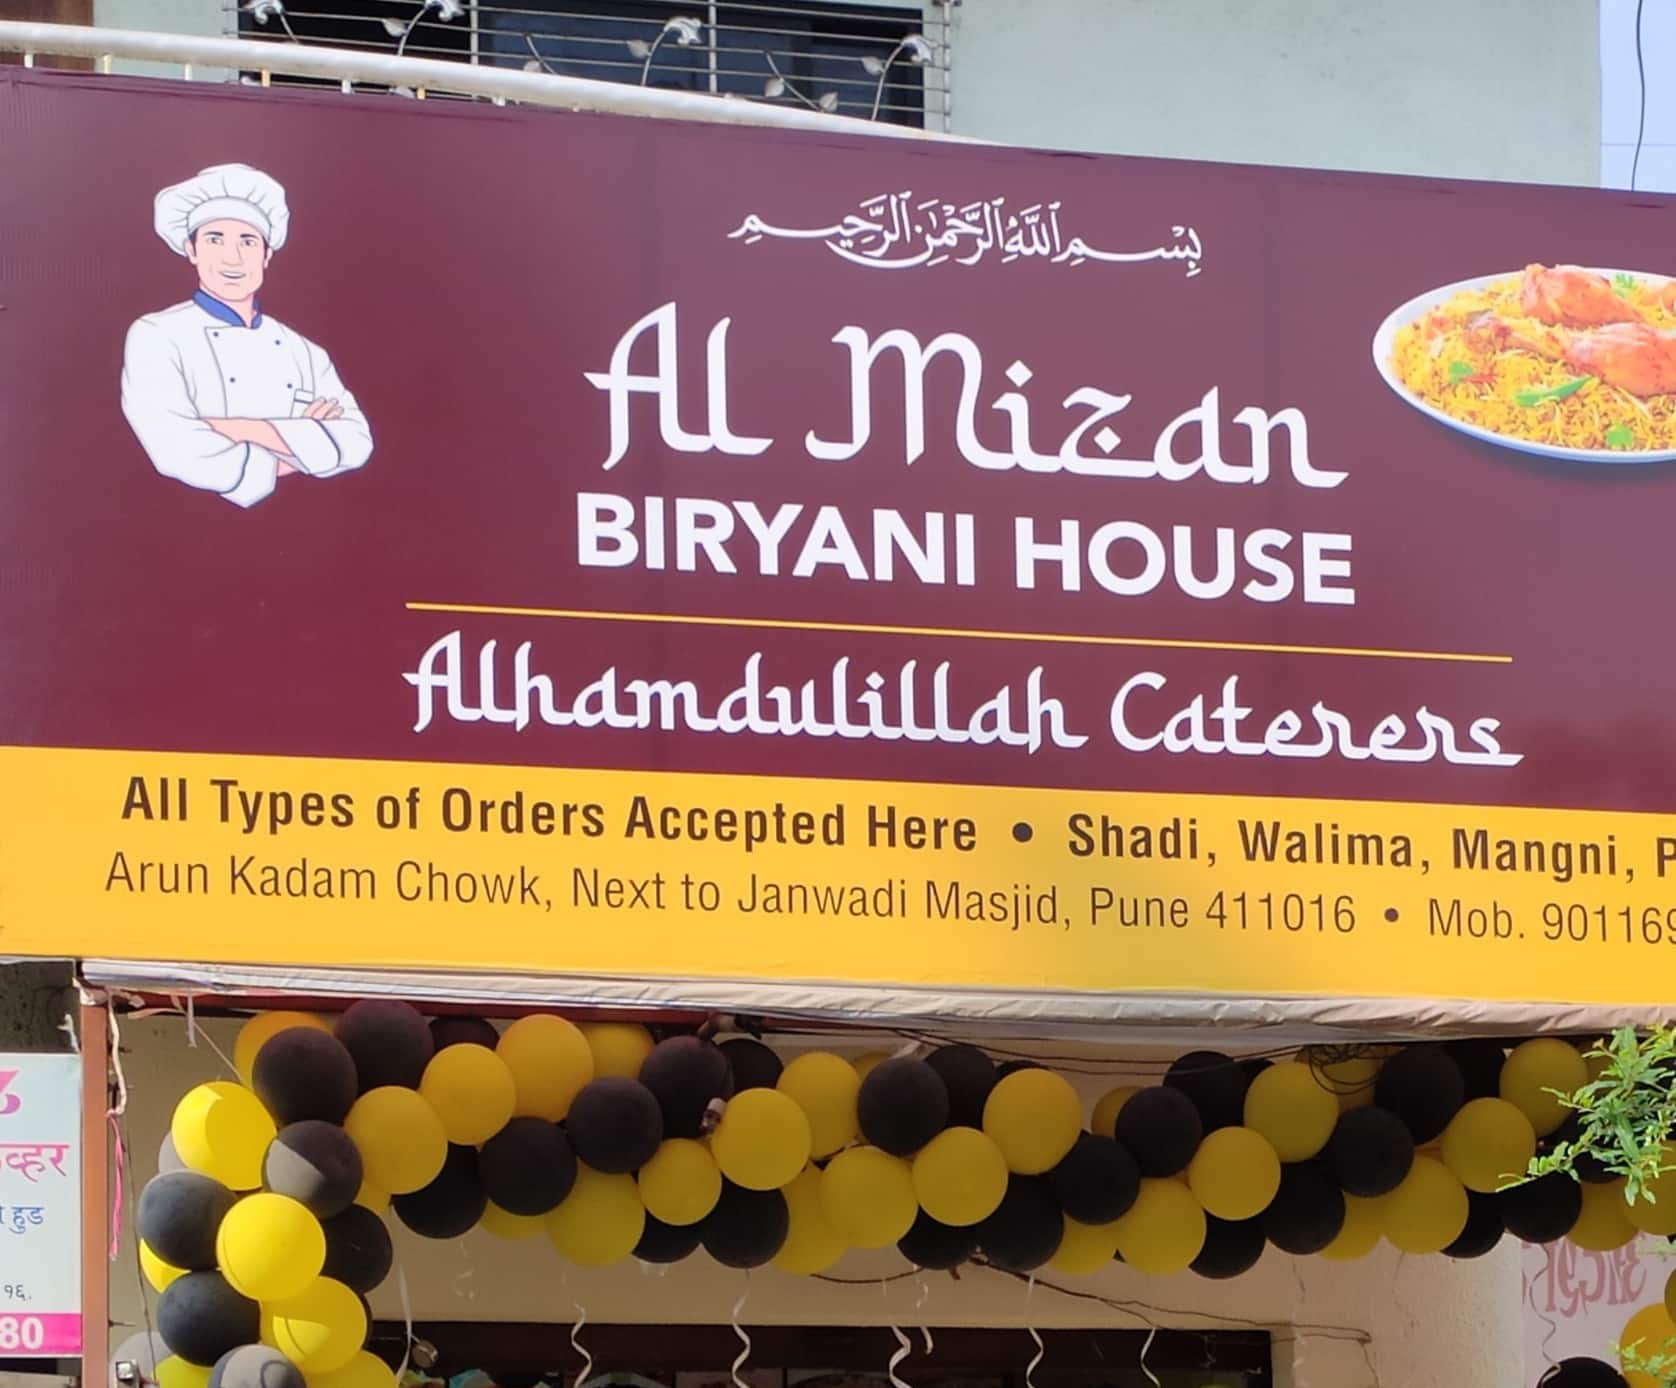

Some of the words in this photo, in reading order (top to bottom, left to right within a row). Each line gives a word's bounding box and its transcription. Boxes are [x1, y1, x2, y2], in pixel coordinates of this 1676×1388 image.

[584, 302, 773, 470] Al
[805, 326, 1349, 488] Mizan
[578, 493, 975, 585] BIRYANI
[1015, 517, 1355, 604] HOUSE
[403, 631, 1088, 754] Alhamdulillah
[1111, 672, 1524, 765] Caterers
[122, 777, 186, 820] All
[210, 780, 353, 834] Types
[377, 787, 419, 829] of
[443, 788, 603, 837] Orders
[625, 797, 844, 852] Accepted
[869, 806, 976, 851] Here
[1069, 814, 1215, 866] Shadi,
[1238, 820, 1428, 874] Walima,
[1454, 829, 1633, 882] Mangni,
[106, 852, 207, 893] Arun
[231, 856, 374, 898] Kadam
[397, 861, 550, 910] Chowk,
[574, 868, 665, 909] Next
[682, 874, 719, 911] to
[738, 874, 905, 917] Janwadi
[927, 881, 1069, 930] Masjid,
[1091, 888, 1188, 927] Pune
[1206, 892, 1355, 932] 411016
[1430, 899, 1523, 938] Mob.
